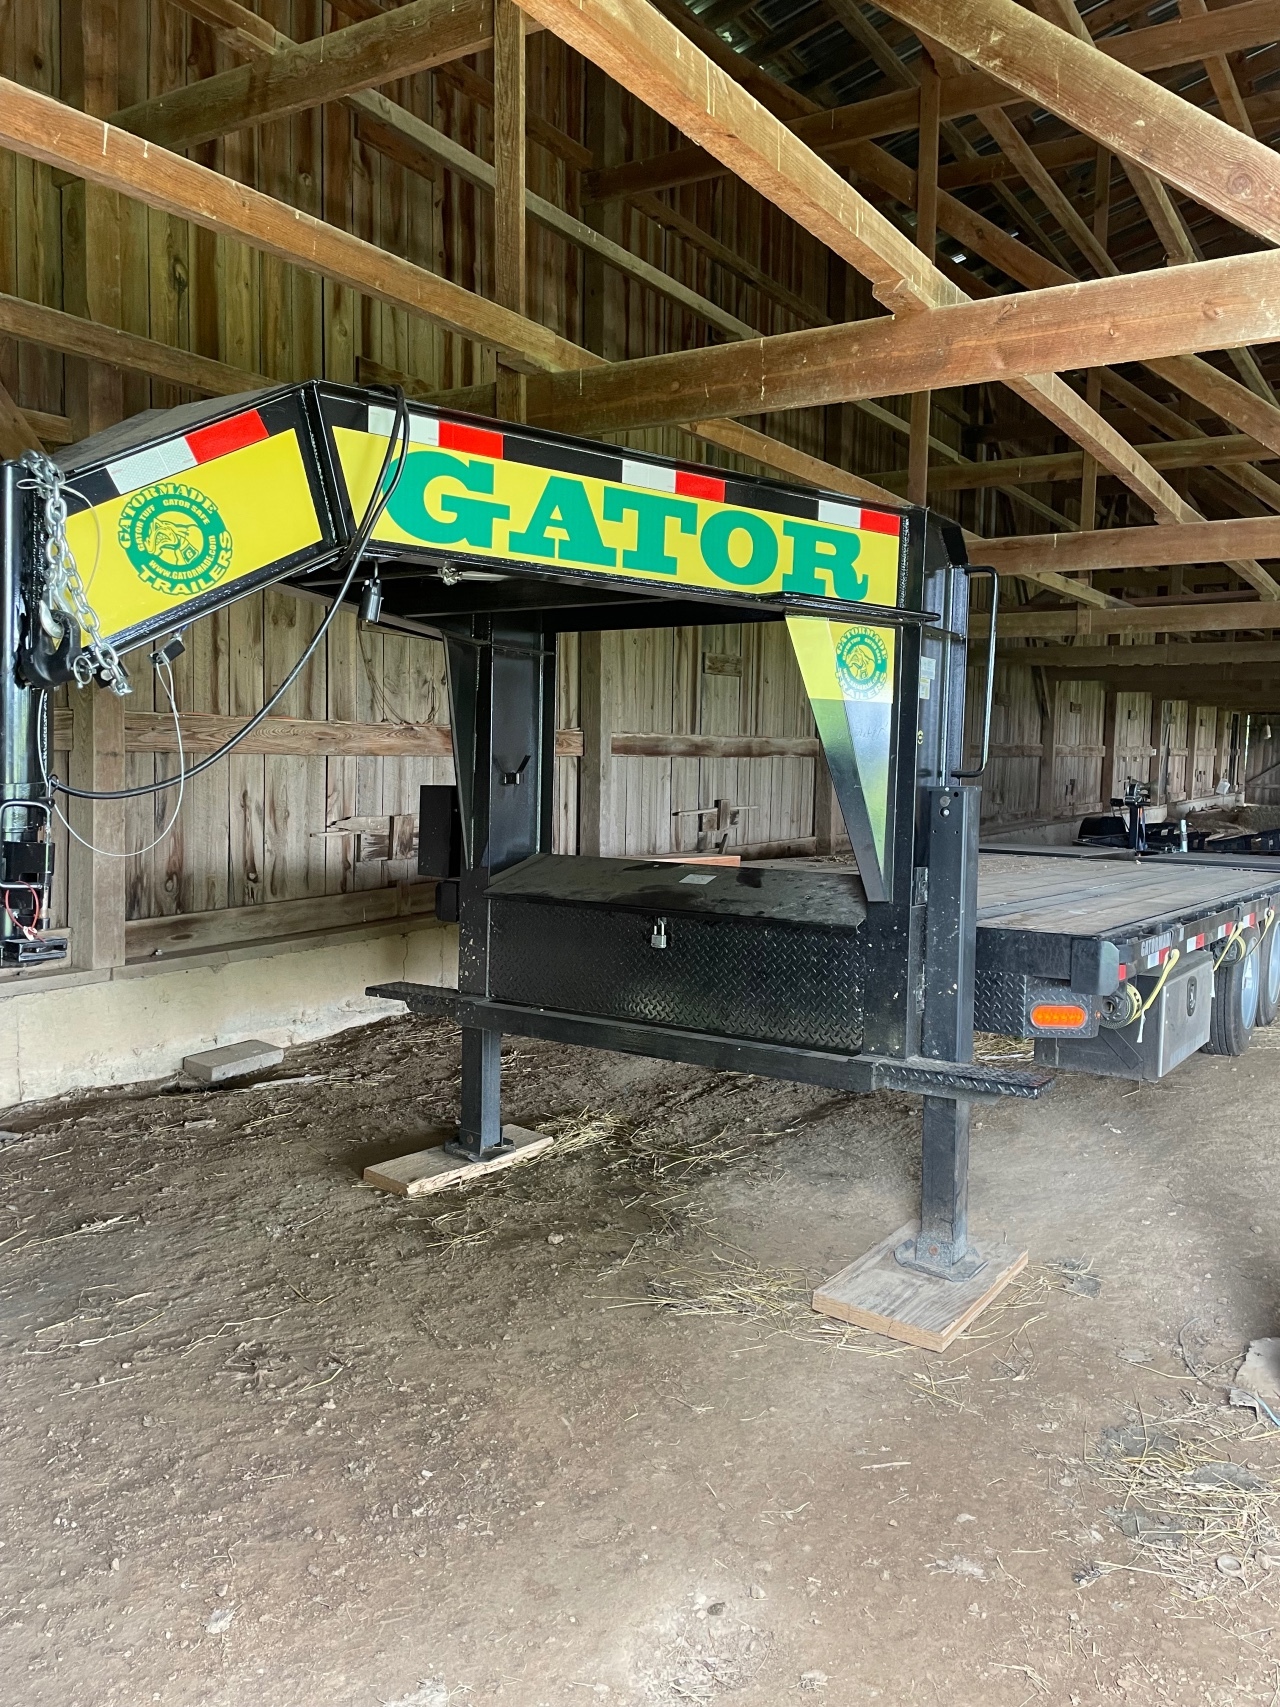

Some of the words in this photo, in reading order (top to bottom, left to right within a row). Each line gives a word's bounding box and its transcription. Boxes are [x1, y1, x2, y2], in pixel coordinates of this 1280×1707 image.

[118, 483, 218, 548] GATORMADE
[139, 504, 156, 521] TUFF
[163, 499, 190, 509] GATOR
[191, 505, 211, 525] SAFE
[381, 450, 869, 601] GATOR
[135, 519, 145, 552] GATOR
[138, 530, 233, 595] TRAILERS
[836, 626, 888, 660] GATORMADE
